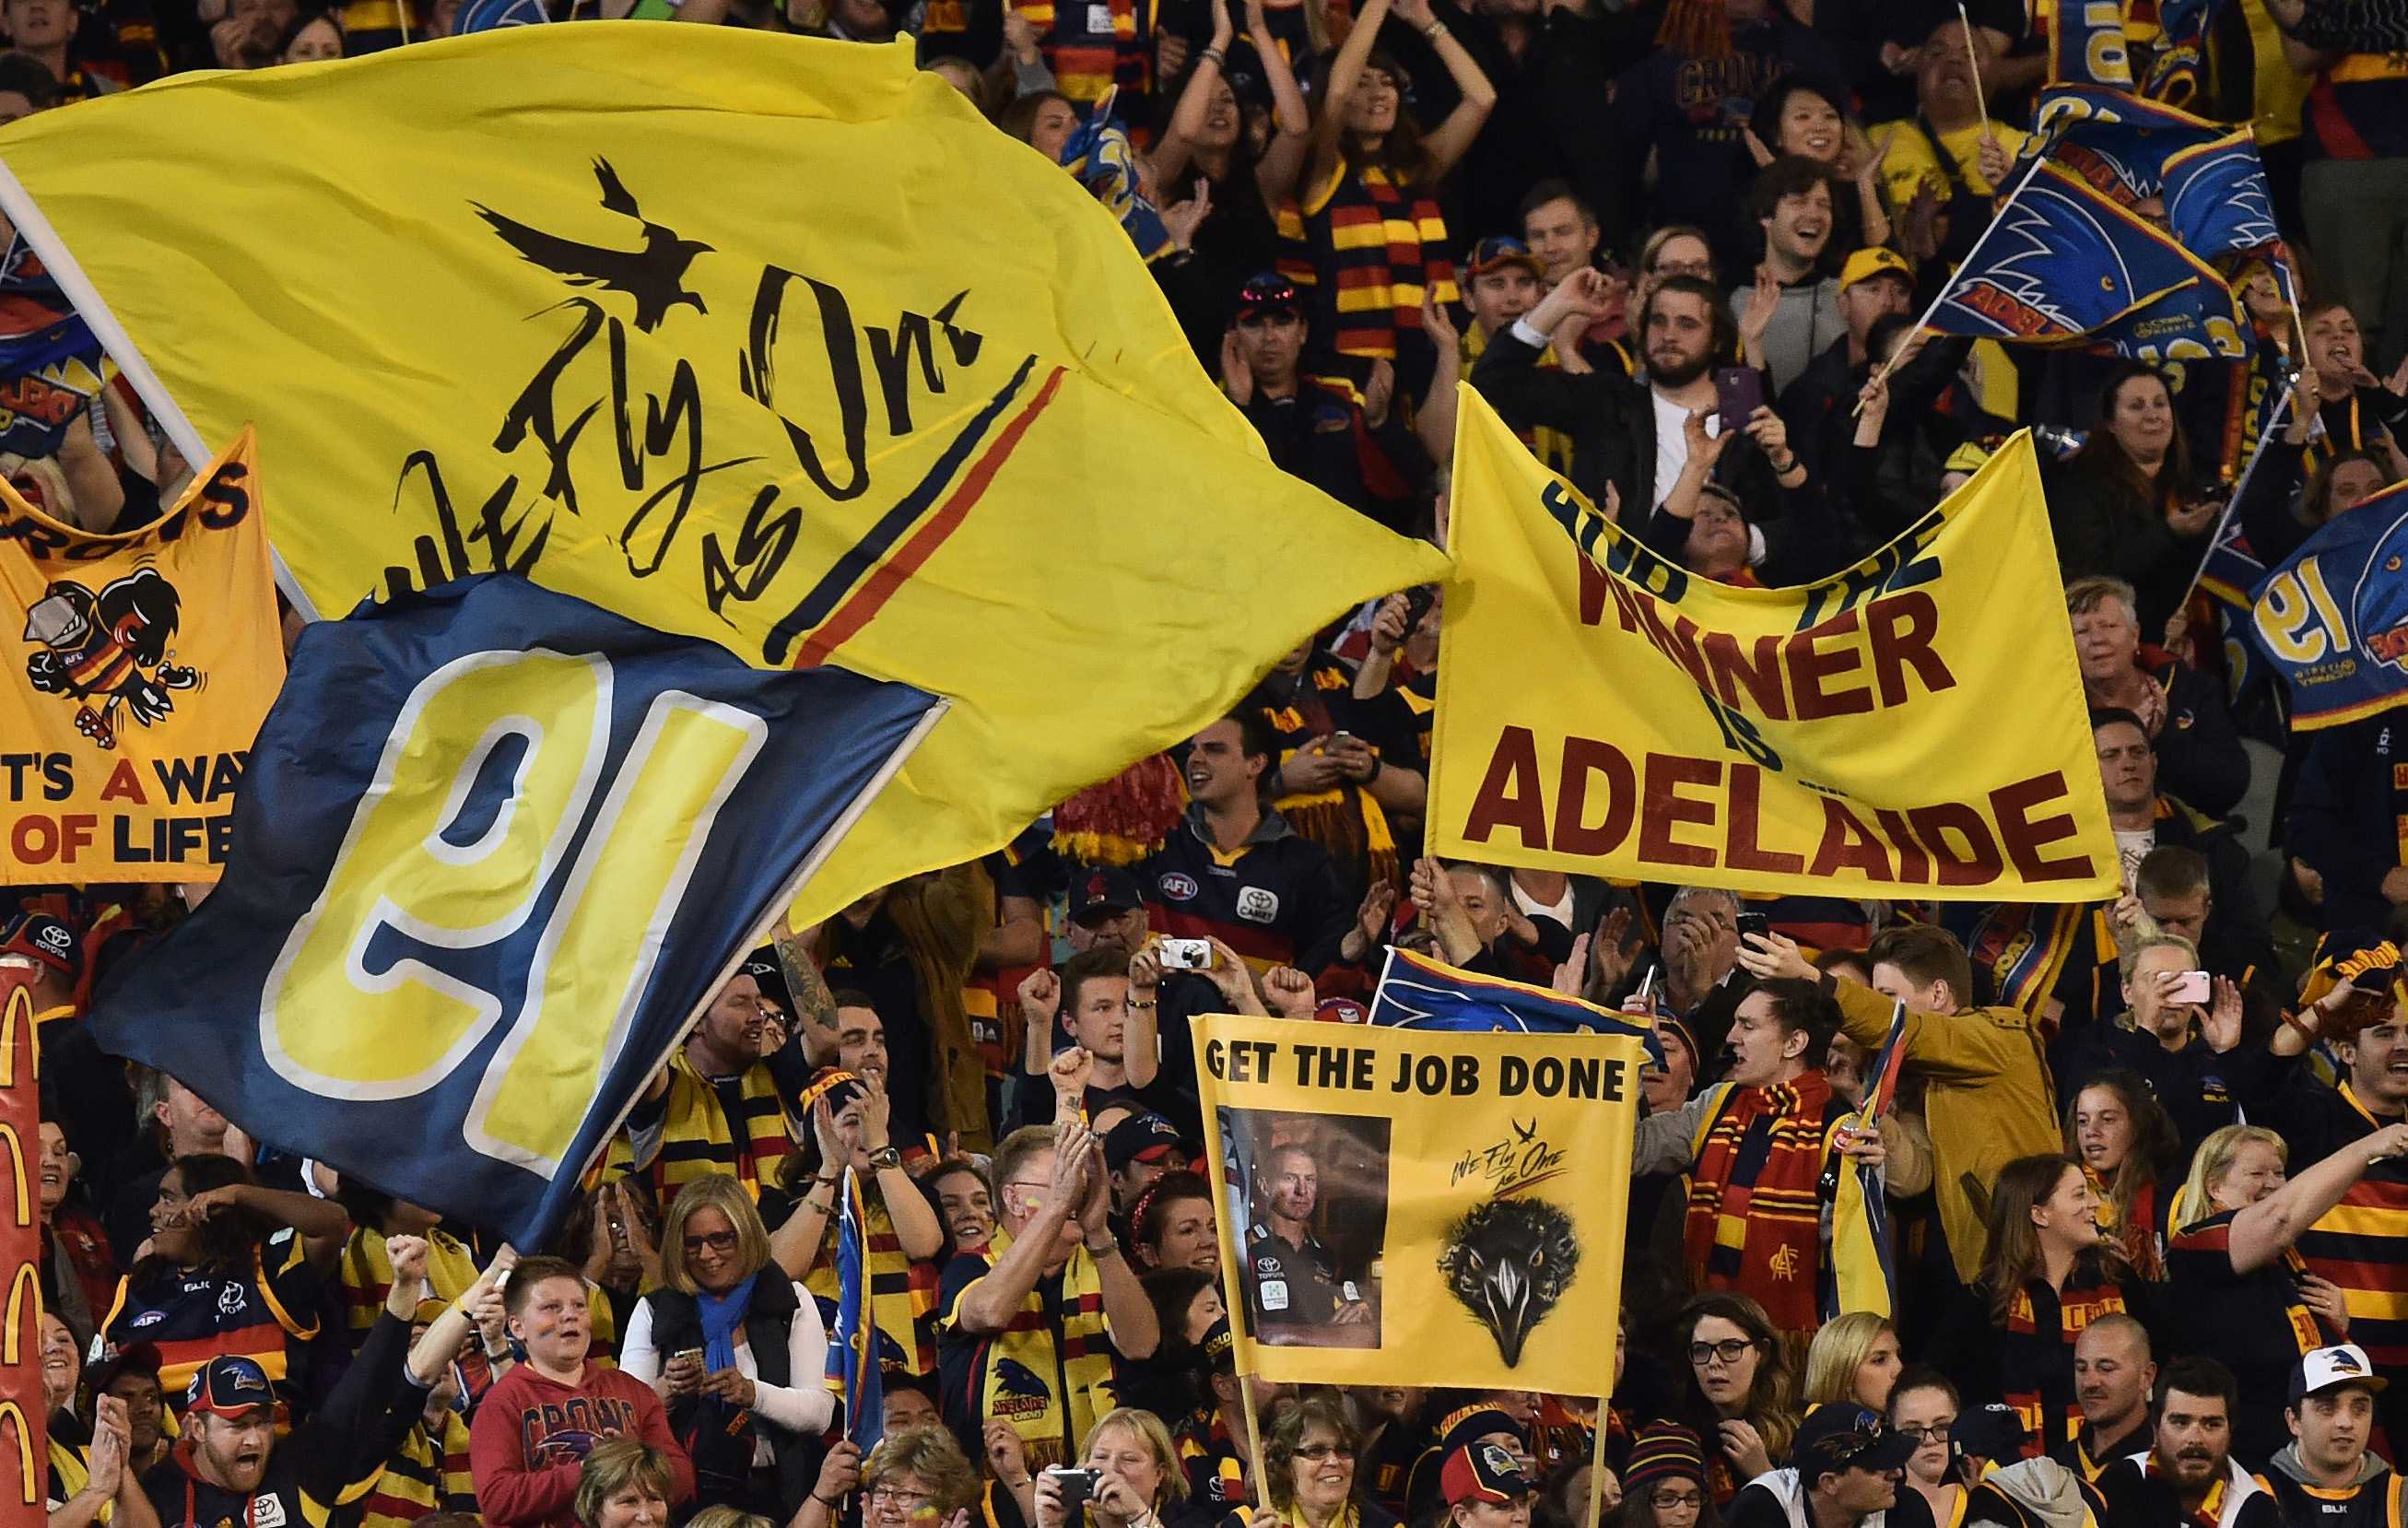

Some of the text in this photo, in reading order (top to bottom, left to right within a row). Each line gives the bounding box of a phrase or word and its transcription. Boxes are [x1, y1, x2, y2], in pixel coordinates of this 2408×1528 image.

[493, 297, 768, 577] Fly
[1578, 547, 1956, 722] WINNER
[1697, 685, 1783, 772] IS
[100, 758, 147, 806] A
[1462, 725, 2097, 887] ADELAIDE
[11, 814, 98, 864] OF
[1163, 878, 1192, 895] AFL
[35, 938, 67, 959] TOYOTA
[1205, 1039, 1627, 1102] GET THE JOB DONE
[1483, 1138, 1517, 1180] Fly
[2321, 1504, 2348, 1514] BLK
